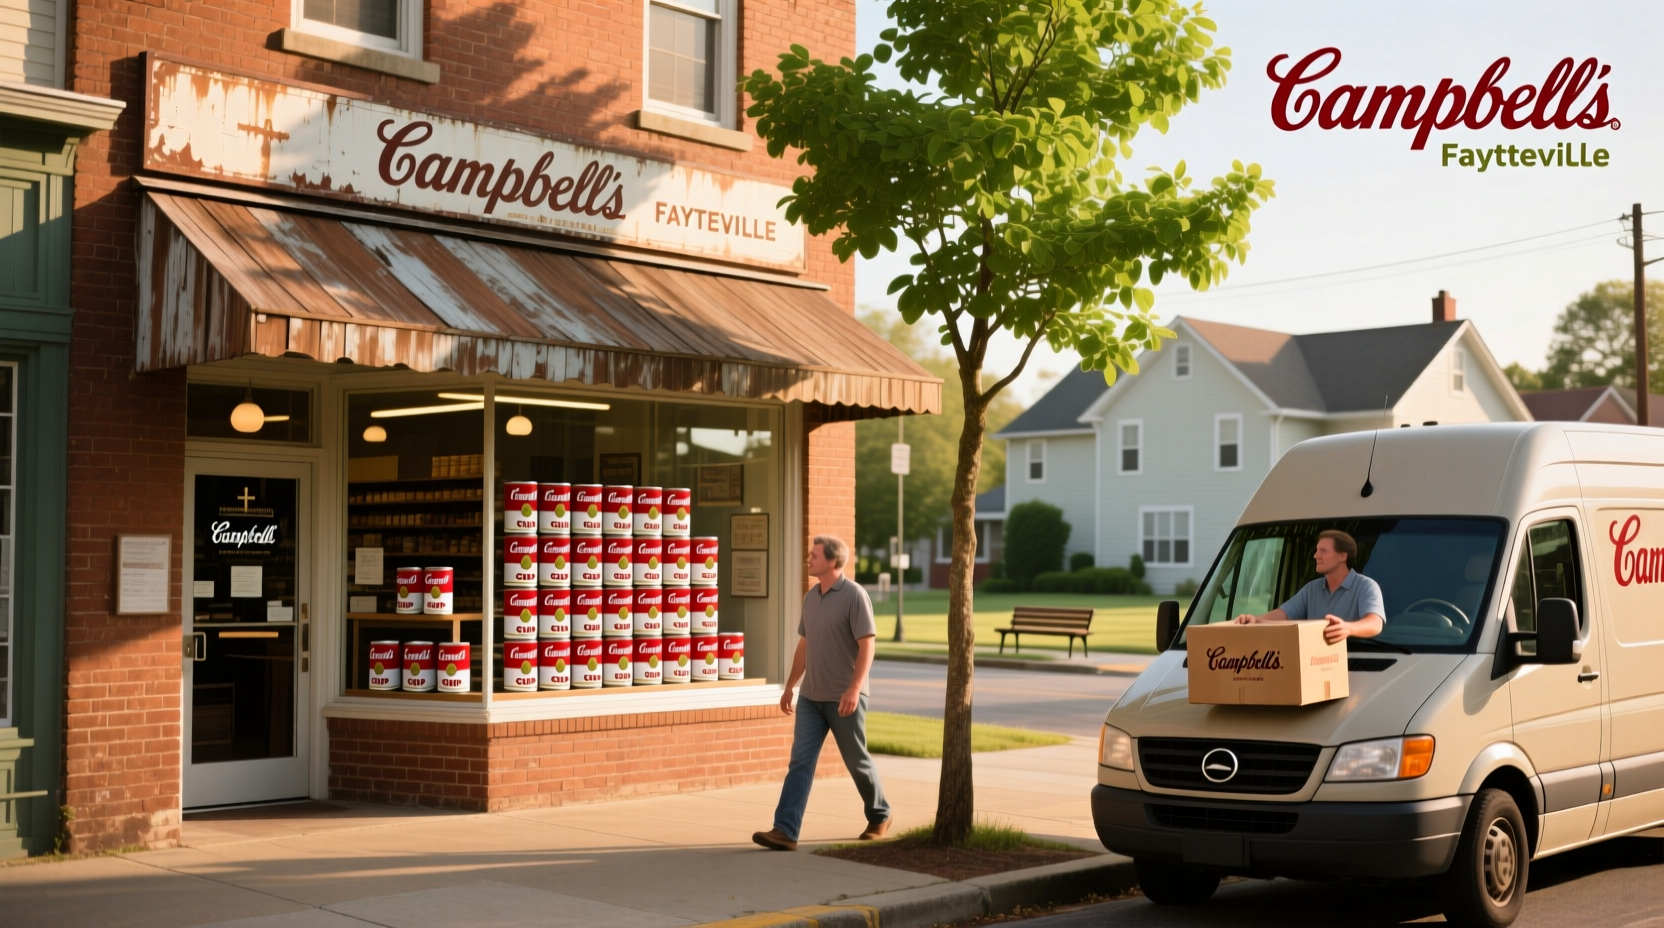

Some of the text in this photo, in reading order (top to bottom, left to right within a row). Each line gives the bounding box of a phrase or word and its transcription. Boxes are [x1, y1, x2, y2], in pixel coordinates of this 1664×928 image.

[376, 118, 777, 242] Campbell's FAYTEVILLE
[1207, 646, 1281, 674] Campbell's
